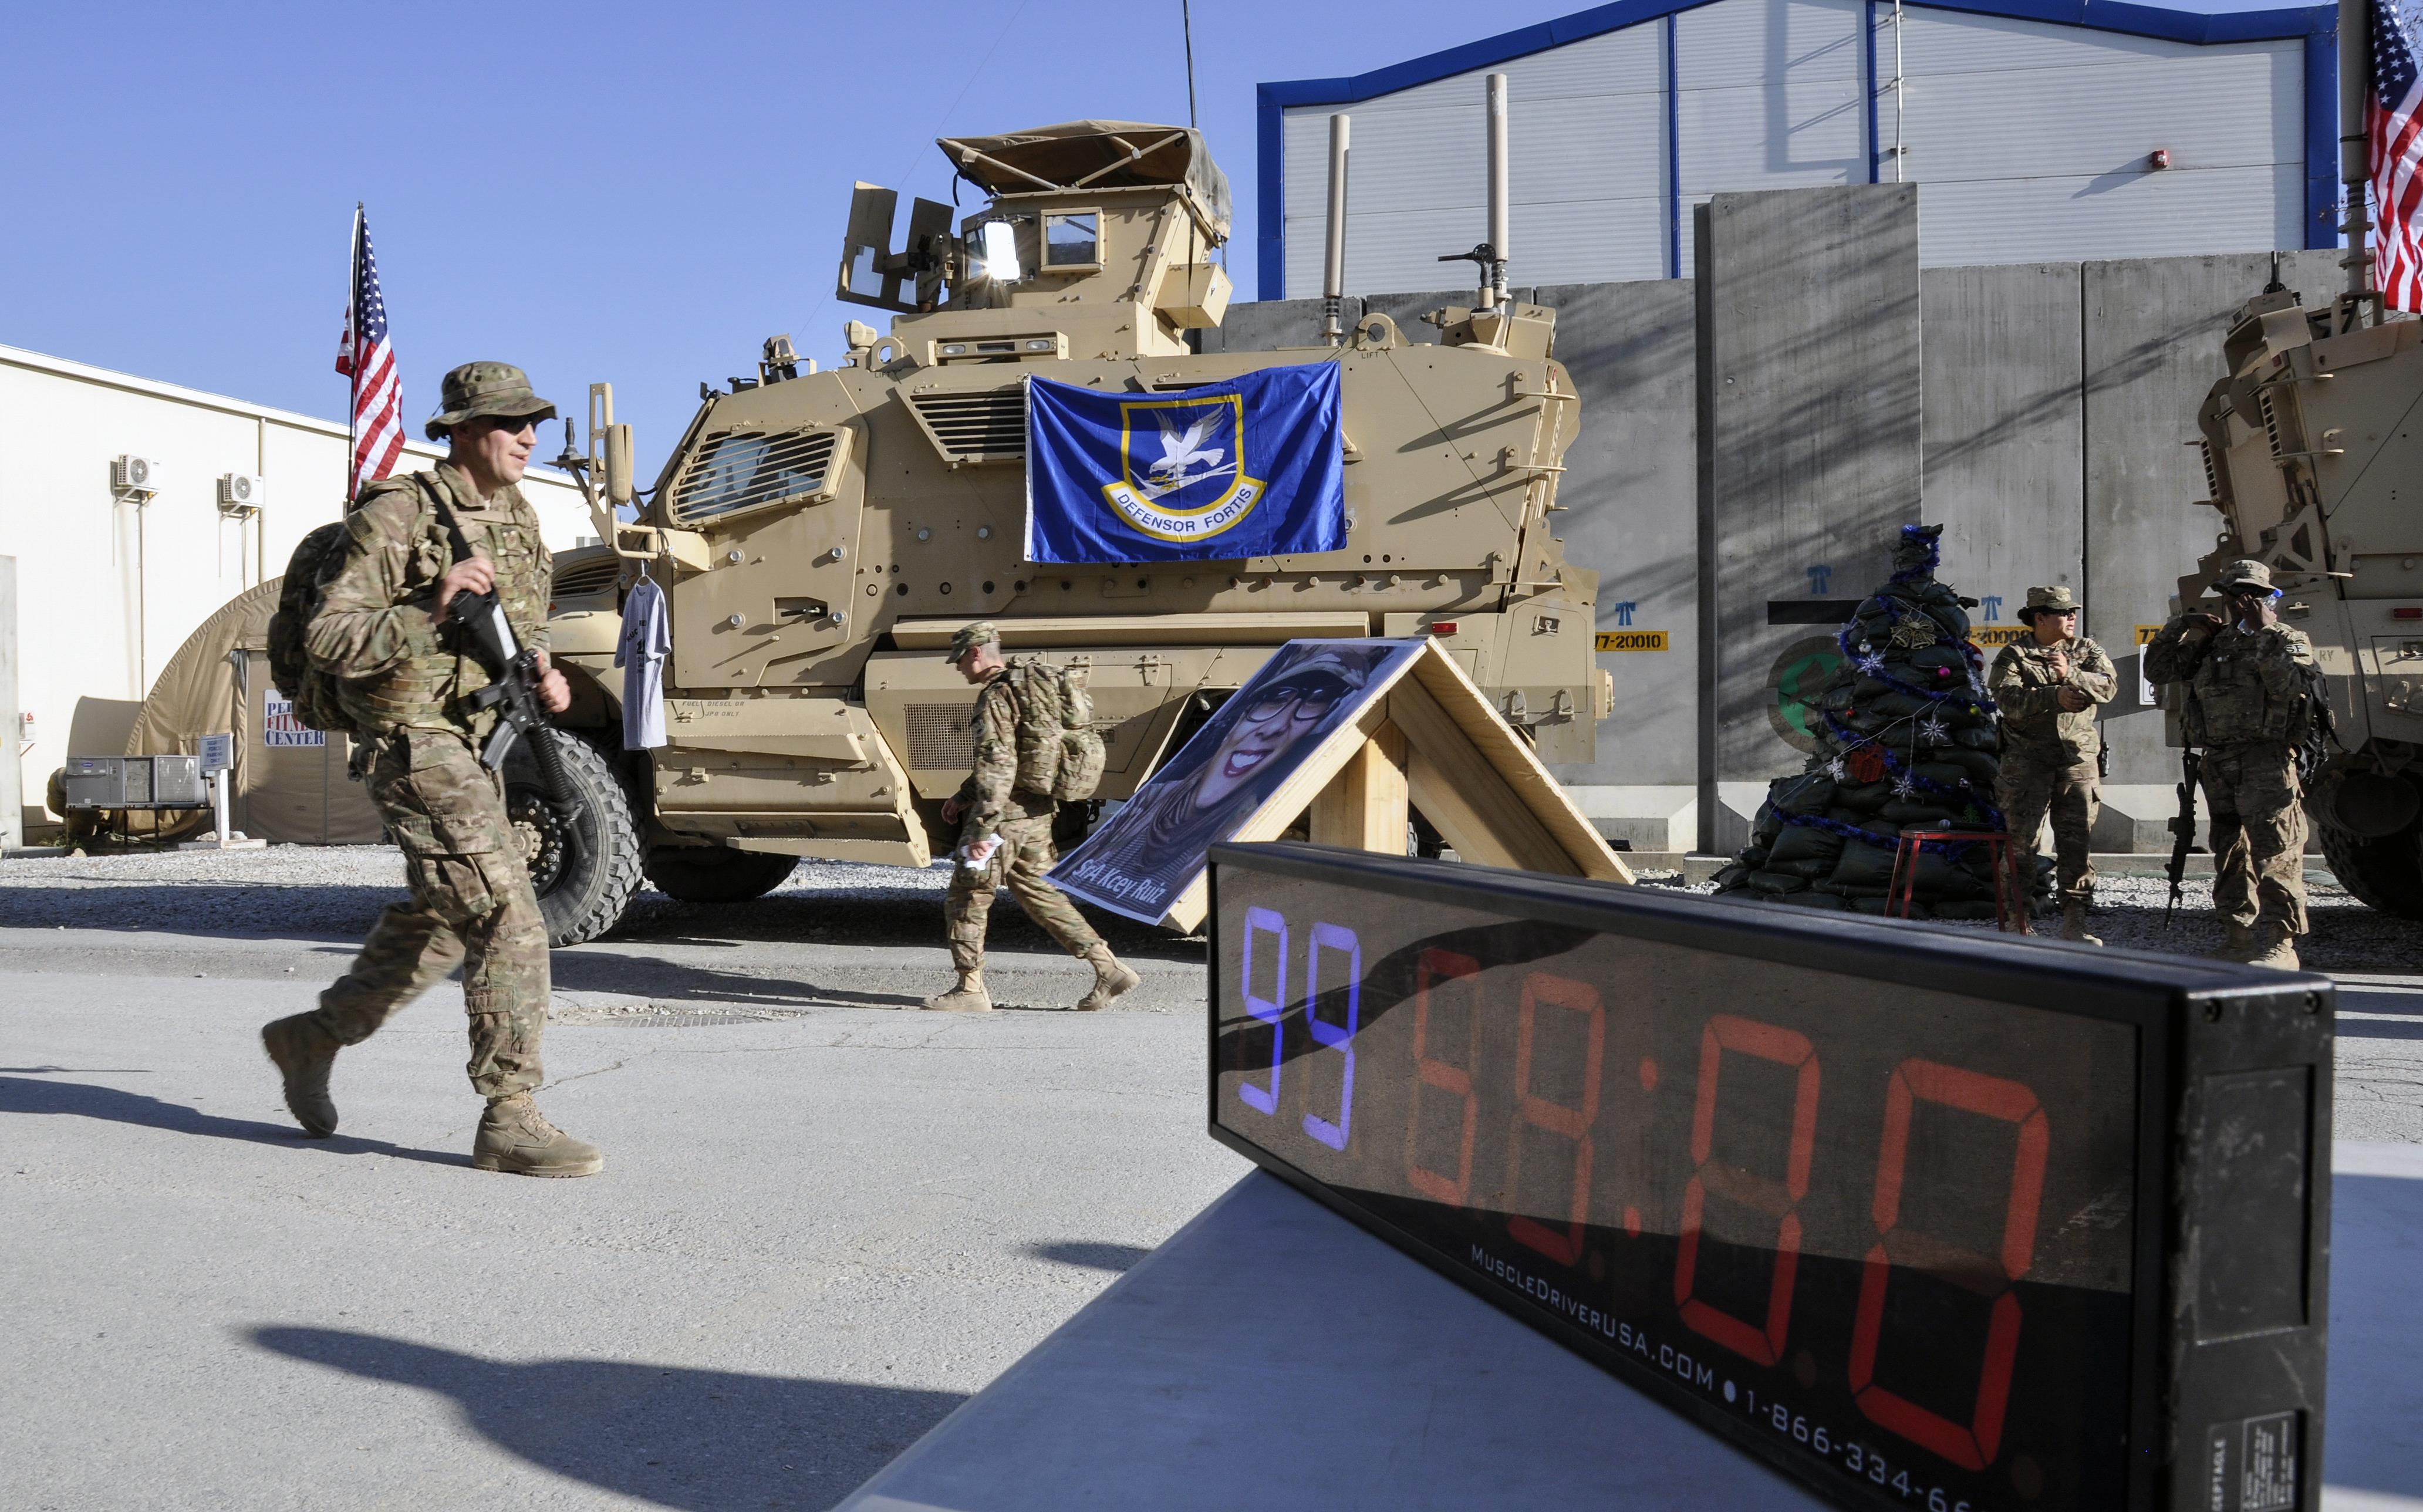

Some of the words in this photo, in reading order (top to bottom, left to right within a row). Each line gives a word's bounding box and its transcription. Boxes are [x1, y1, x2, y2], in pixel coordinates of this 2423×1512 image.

[1118, 494, 1195, 532] DEFENSOR
[1204, 488, 1251, 528] FORTIS
[266, 730, 324, 745] CENTER
[1072, 859, 1106, 882] SrA
[1130, 879, 1167, 903] Ruiz
[1238, 905, 1362, 1152] 99
